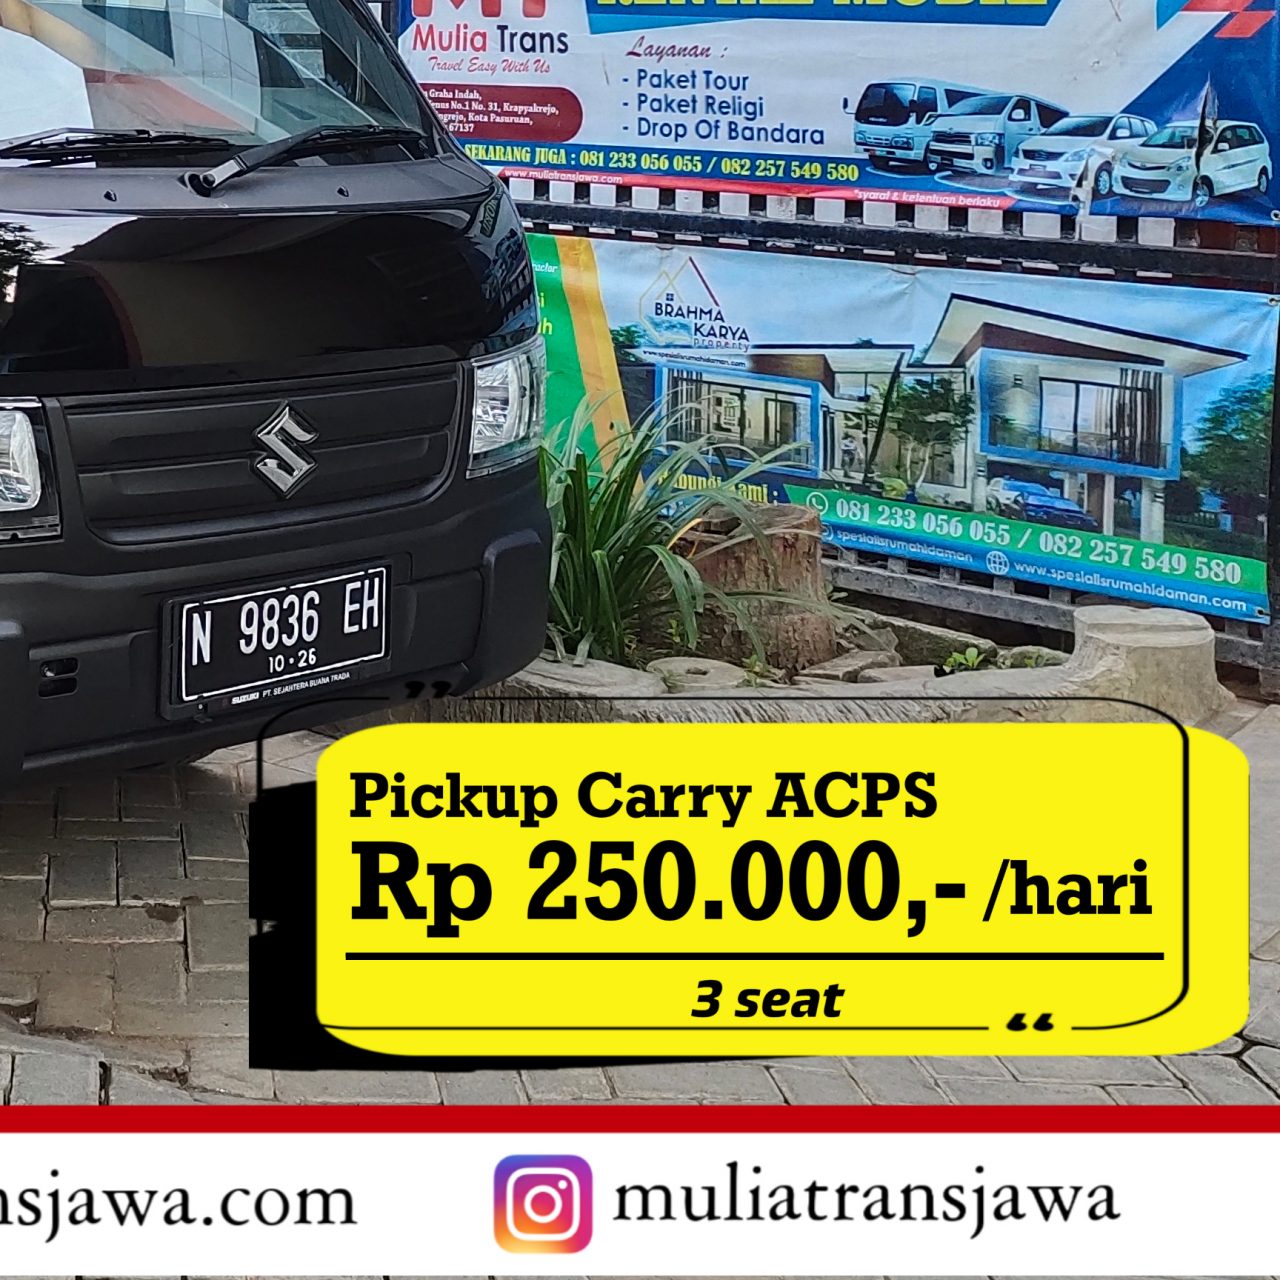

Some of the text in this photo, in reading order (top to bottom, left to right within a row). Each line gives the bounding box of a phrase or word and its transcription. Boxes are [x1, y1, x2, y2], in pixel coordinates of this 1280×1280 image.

[412, 23, 569, 54] Mulia Trans
[626, 35, 712, 63] Layanan
[428, 56, 551, 77] Travel Easy With Us
[636, 69, 697, 90] Paket
[703, 70, 750, 91] Tour
[468, 112, 488, 122] Kota
[636, 93, 698, 114] Paket
[704, 95, 764, 121] Religi
[636, 117, 688, 142] Drop
[695, 119, 720, 140] Of
[728, 120, 825, 145] Bandara
[464, 144, 531, 162] SEKARANG
[534, 147, 567, 165] JUGA
[579, 150, 605, 167] 081
[608, 151, 637, 168] 233
[640, 153, 670, 170] 056
[673, 155, 703, 172] 055
[721, 158, 751, 175] 082
[754, 160, 786, 177] 257
[790, 161, 822, 179] 549
[826, 163, 860, 182] 580
[504, 169, 624, 184] www.muliatransjawa.com
[654, 302, 725, 323] BRAHMA
[693, 322, 750, 343] KARYA
[693, 337, 750, 353] property
[836, 498, 870, 521] 081
[877, 505, 917, 529] 233
[923, 512, 963, 538] 056
[969, 519, 1010, 546] 055
[1039, 531, 1083, 558] 082
[1088, 539, 1135, 567] 257
[1141, 547, 1188, 575] 549
[1194, 556, 1242, 585] 580
[1013, 561, 1248, 612] www.spesialisrumahidaman.com
[191, 577, 380, 666] N 9836 EH
